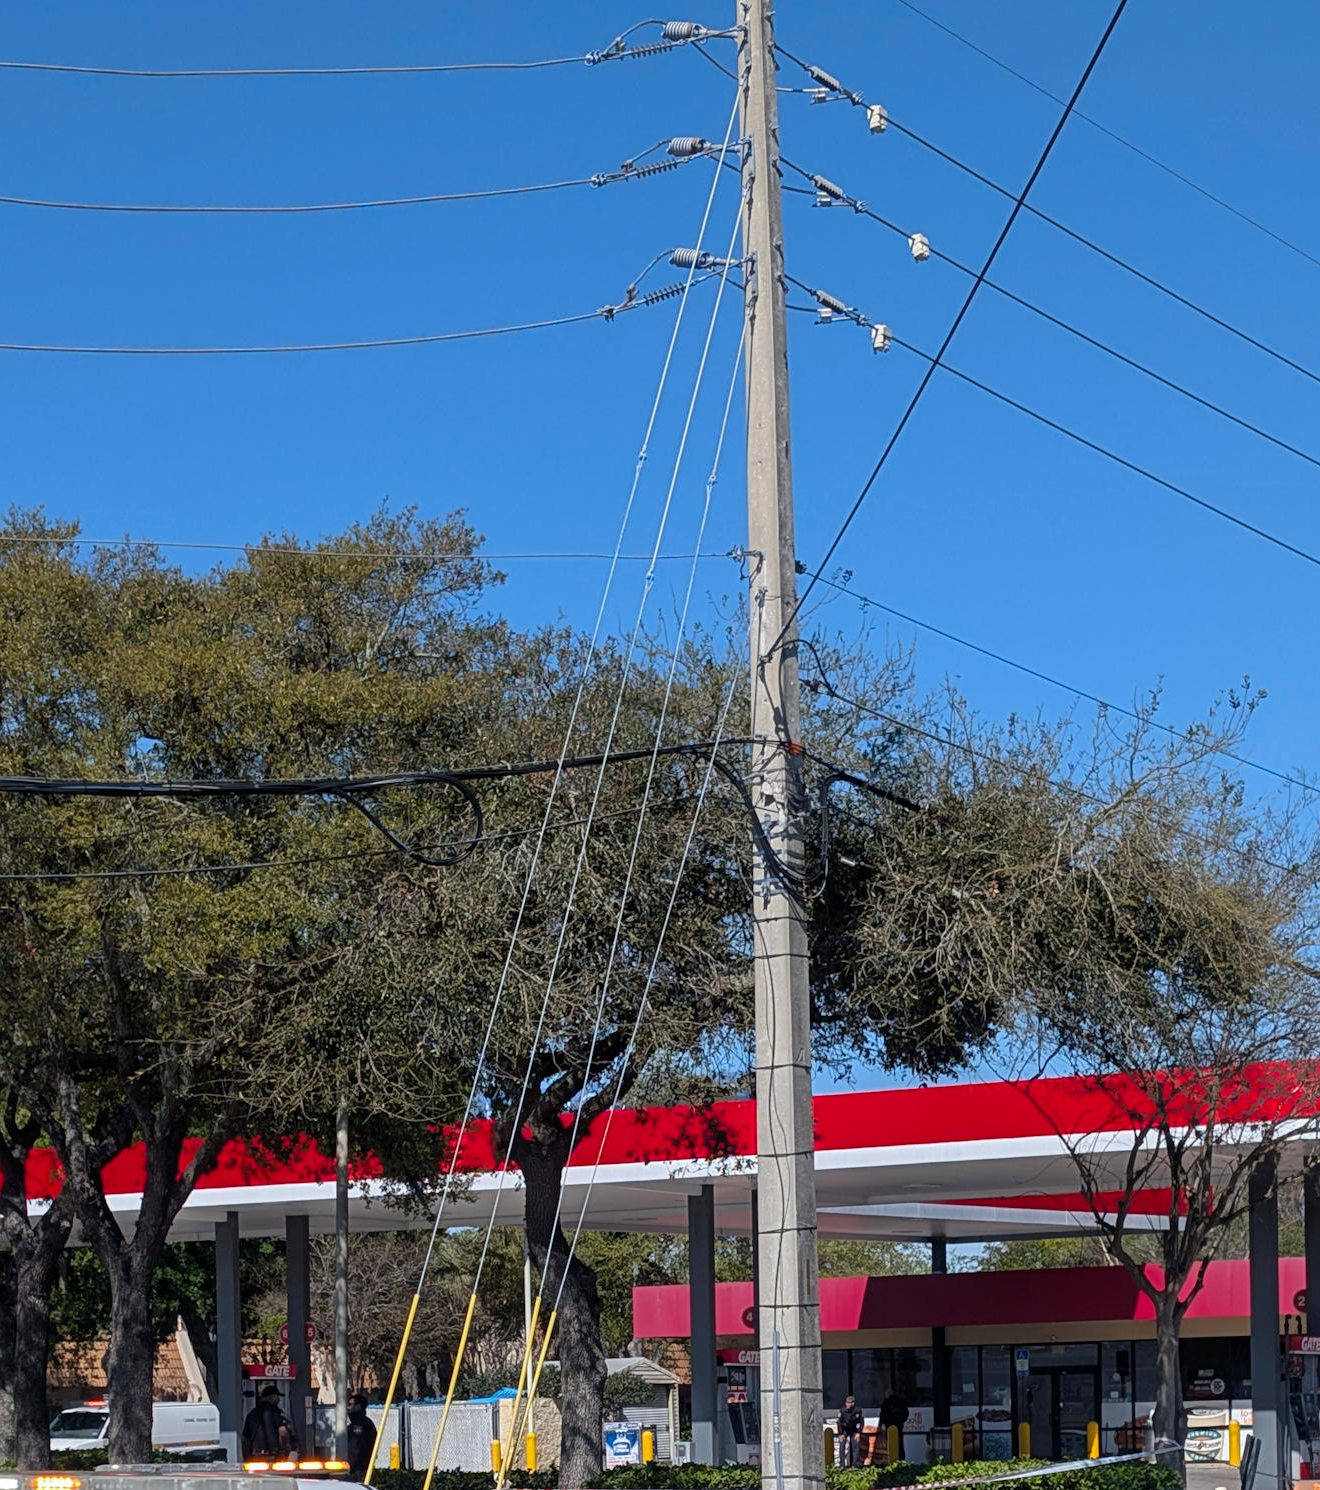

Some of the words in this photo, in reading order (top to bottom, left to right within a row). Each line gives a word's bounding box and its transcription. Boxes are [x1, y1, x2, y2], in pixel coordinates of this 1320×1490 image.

[1297, 1295, 1306, 1307] 2
[746, 1312, 753, 1321] 4
[264, 1364, 290, 1377] GATE
